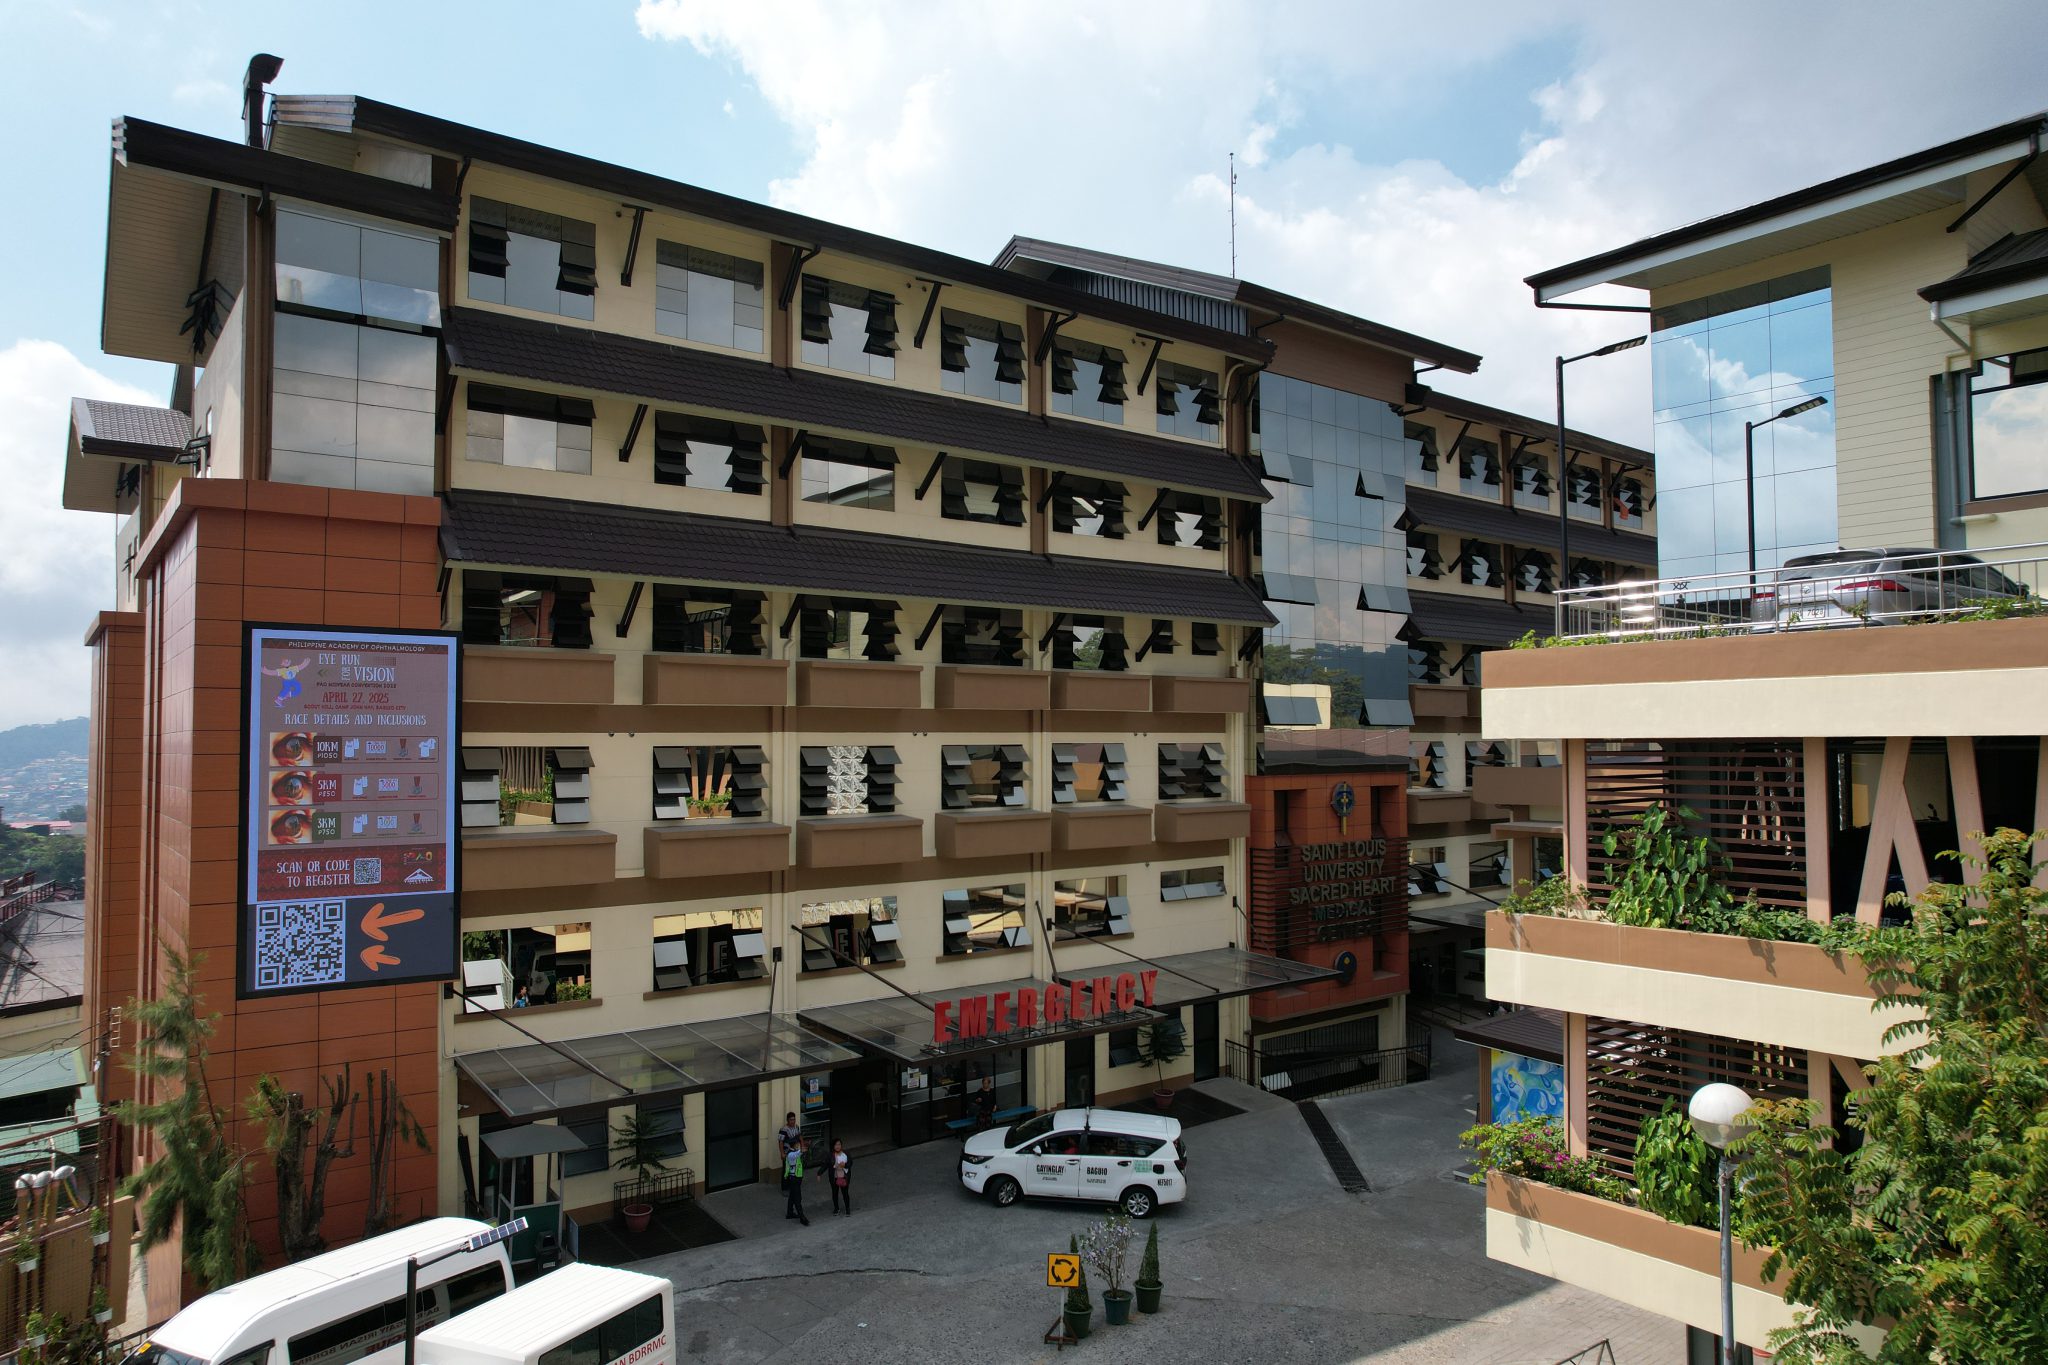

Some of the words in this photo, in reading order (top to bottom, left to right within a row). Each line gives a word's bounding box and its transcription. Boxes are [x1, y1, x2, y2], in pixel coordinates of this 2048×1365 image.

[288, 640, 327, 649] PHILIPPINE
[371, 643, 426, 652] OPHTHALMOLOGY
[318, 653, 337, 665] EYE
[341, 654, 360, 666] RUN
[354, 666, 395, 682] VISION
[322, 691, 348, 703] APRIL
[368, 692, 389, 704] 2025
[284, 713, 308, 725] RACE
[314, 713, 350, 725] DETAILS
[354, 714, 373, 725] AND
[377, 714, 427, 726] INCLUSIONS
[316, 741, 339, 753] 10KM
[317, 779, 337, 790] 5KM
[317, 817, 336, 829] 3KM
[1301, 843, 1344, 862] SAINT
[1347, 839, 1387, 858] LOUIS
[276, 860, 303, 874] SCAN
[307, 860, 321, 873] QR
[325, 859, 350, 872] CODE
[1303, 858, 1385, 882] UNIVERSITY
[287, 876, 301, 888] TO
[305, 873, 350, 887] REGISTER
[1288, 882, 1349, 905] SACRED
[1353, 876, 1397, 898] HEART
[1311, 898, 1377, 921] MEDICAL
[934, 969, 1158, 1043] EMERGENCY
[1086, 1165, 1108, 1176] BAGUIO
[628, 1335, 667, 1364] BDRRMC
